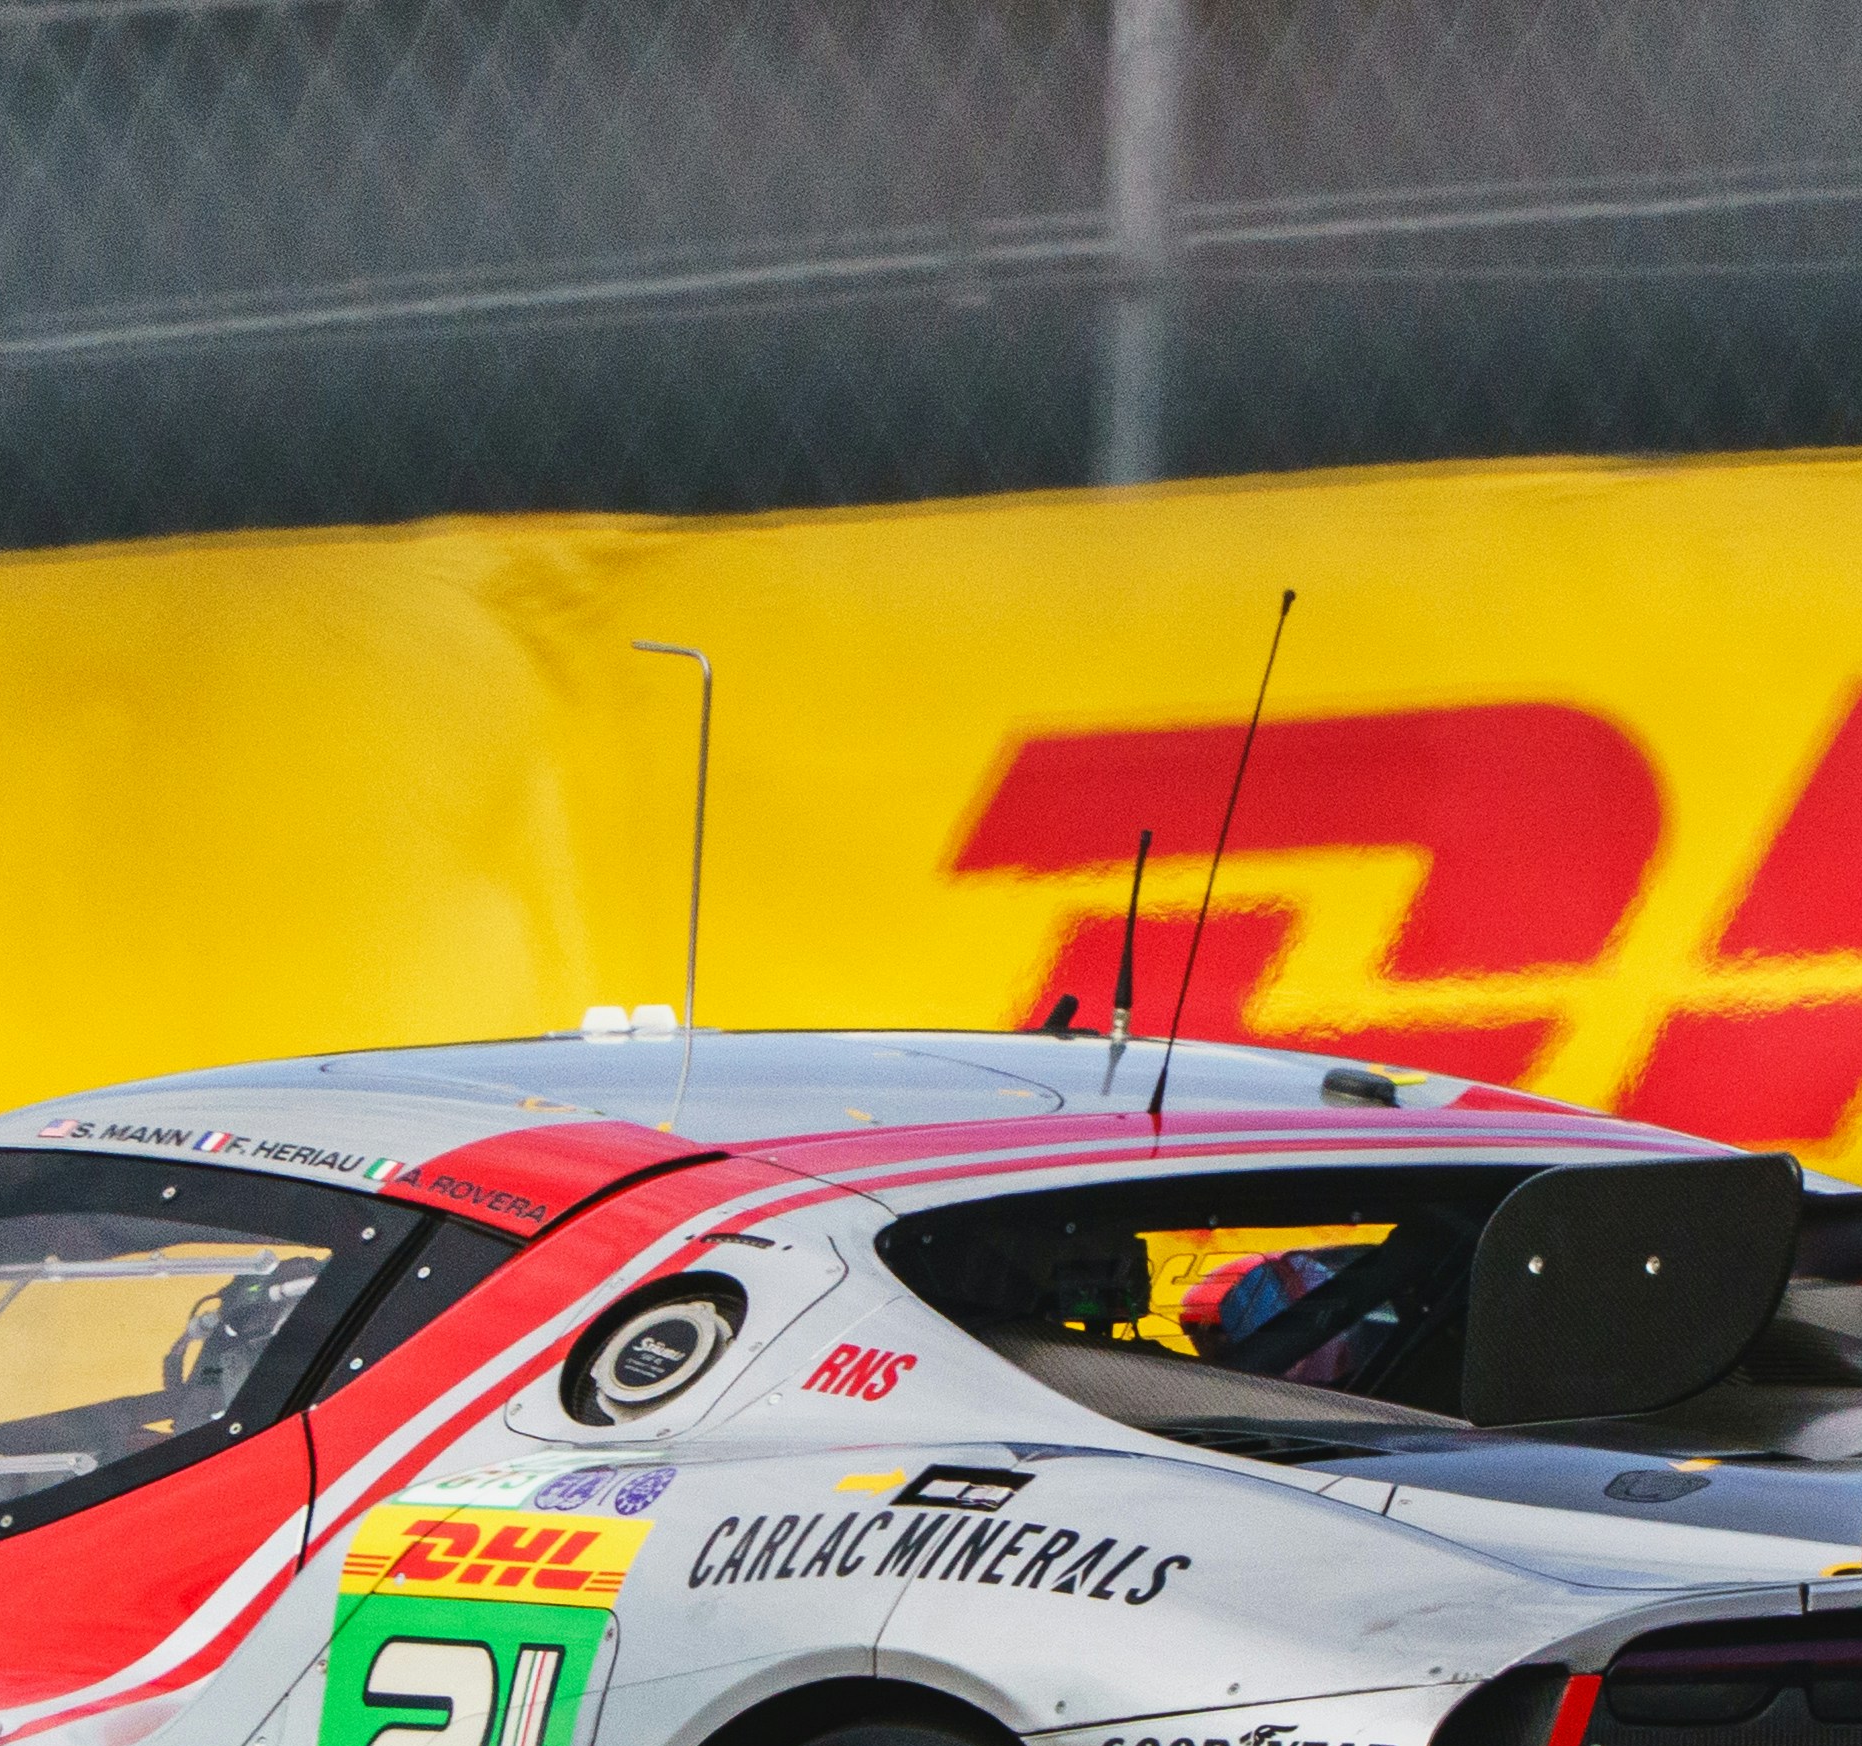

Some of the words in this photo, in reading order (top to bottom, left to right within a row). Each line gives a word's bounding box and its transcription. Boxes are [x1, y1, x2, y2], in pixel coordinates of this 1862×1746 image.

[70, 1121, 95, 1141] S.
[105, 1123, 193, 1149] MANN
[225, 1136, 253, 1158] F.
[253, 1137, 366, 1175] HERIAU
[395, 1166, 425, 1189] A.
[433, 1175, 548, 1222] ROVERA
[801, 1343, 918, 1401] RNS
[387, 1519, 602, 1590] DHL
[688, 1511, 895, 1589] CARLAC
[874, 1512, 1193, 1606] MINERALS
